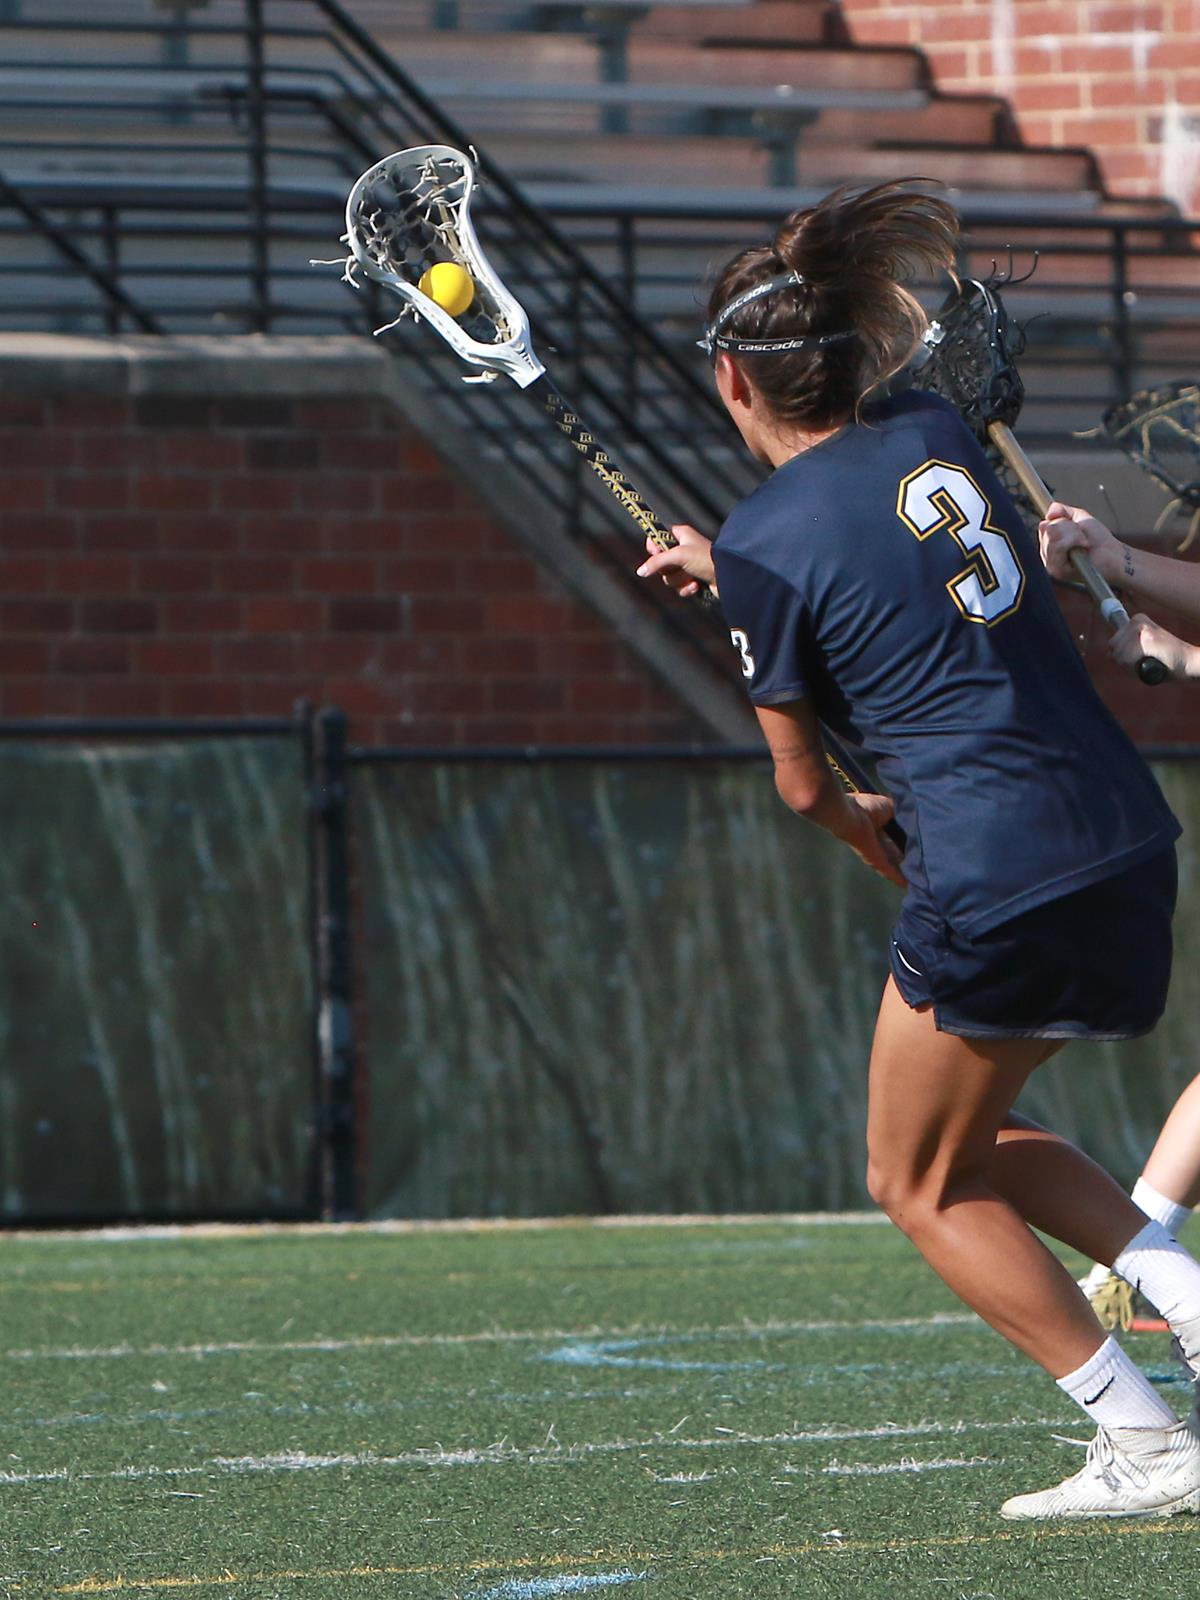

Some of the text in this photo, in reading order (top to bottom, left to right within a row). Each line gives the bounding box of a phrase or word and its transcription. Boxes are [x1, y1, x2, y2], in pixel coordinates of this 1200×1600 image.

[719, 282, 773, 323] cascade
[738, 339, 804, 351] cascade
[896, 458, 1026, 628] 3
[730, 627, 755, 680] 3
